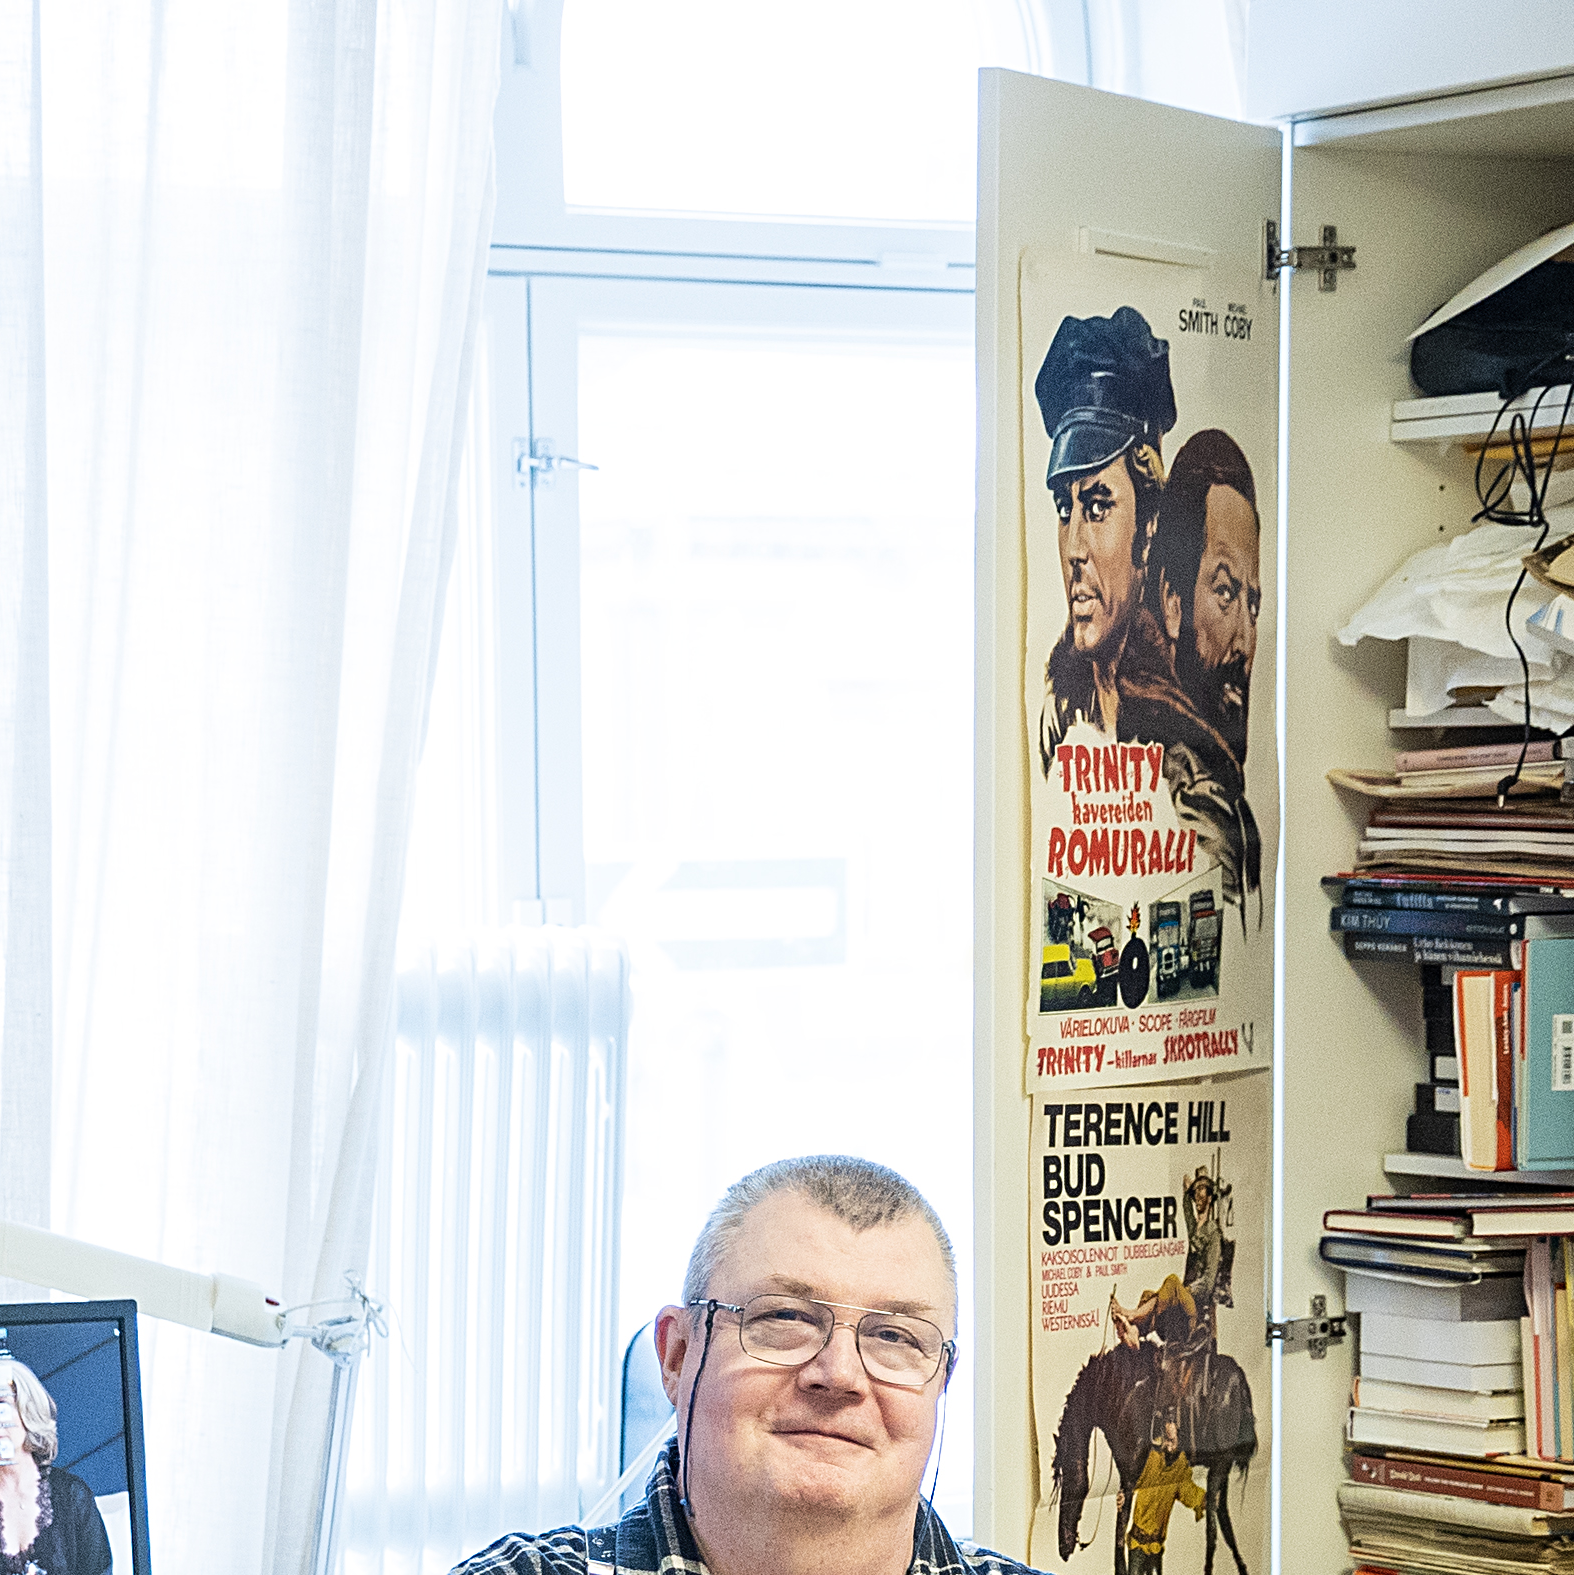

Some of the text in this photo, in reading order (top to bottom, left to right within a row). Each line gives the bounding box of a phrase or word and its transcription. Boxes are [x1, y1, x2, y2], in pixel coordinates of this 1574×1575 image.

[1179, 309, 1253, 341] SMITH COBY
[1057, 744, 1163, 793] TRINITY
[1071, 791, 1153, 825] kavereiden
[1047, 827, 1197, 878] ROMURALLI
[1059, 1015, 1130, 1039] VÄRIELOKUVA
[1139, 1012, 1173, 1034] SCOPE
[1037, 1043, 1106, 1077] TRINITY
[1163, 1028, 1238, 1065] SKROTRALLY
[1043, 1100, 1231, 1147] TERENCE HILL
[1043, 1153, 1106, 1199] BUD
[1042, 1196, 1178, 1246] SPENCER
[1041, 1246, 1118, 1266] KAKSOISOLENNOT
[1041, 1281, 1080, 1299] UUDESSA
[1041, 1299, 1069, 1316] RIEMU
[1041, 1308, 1100, 1332] WESTERNISSÄ!
